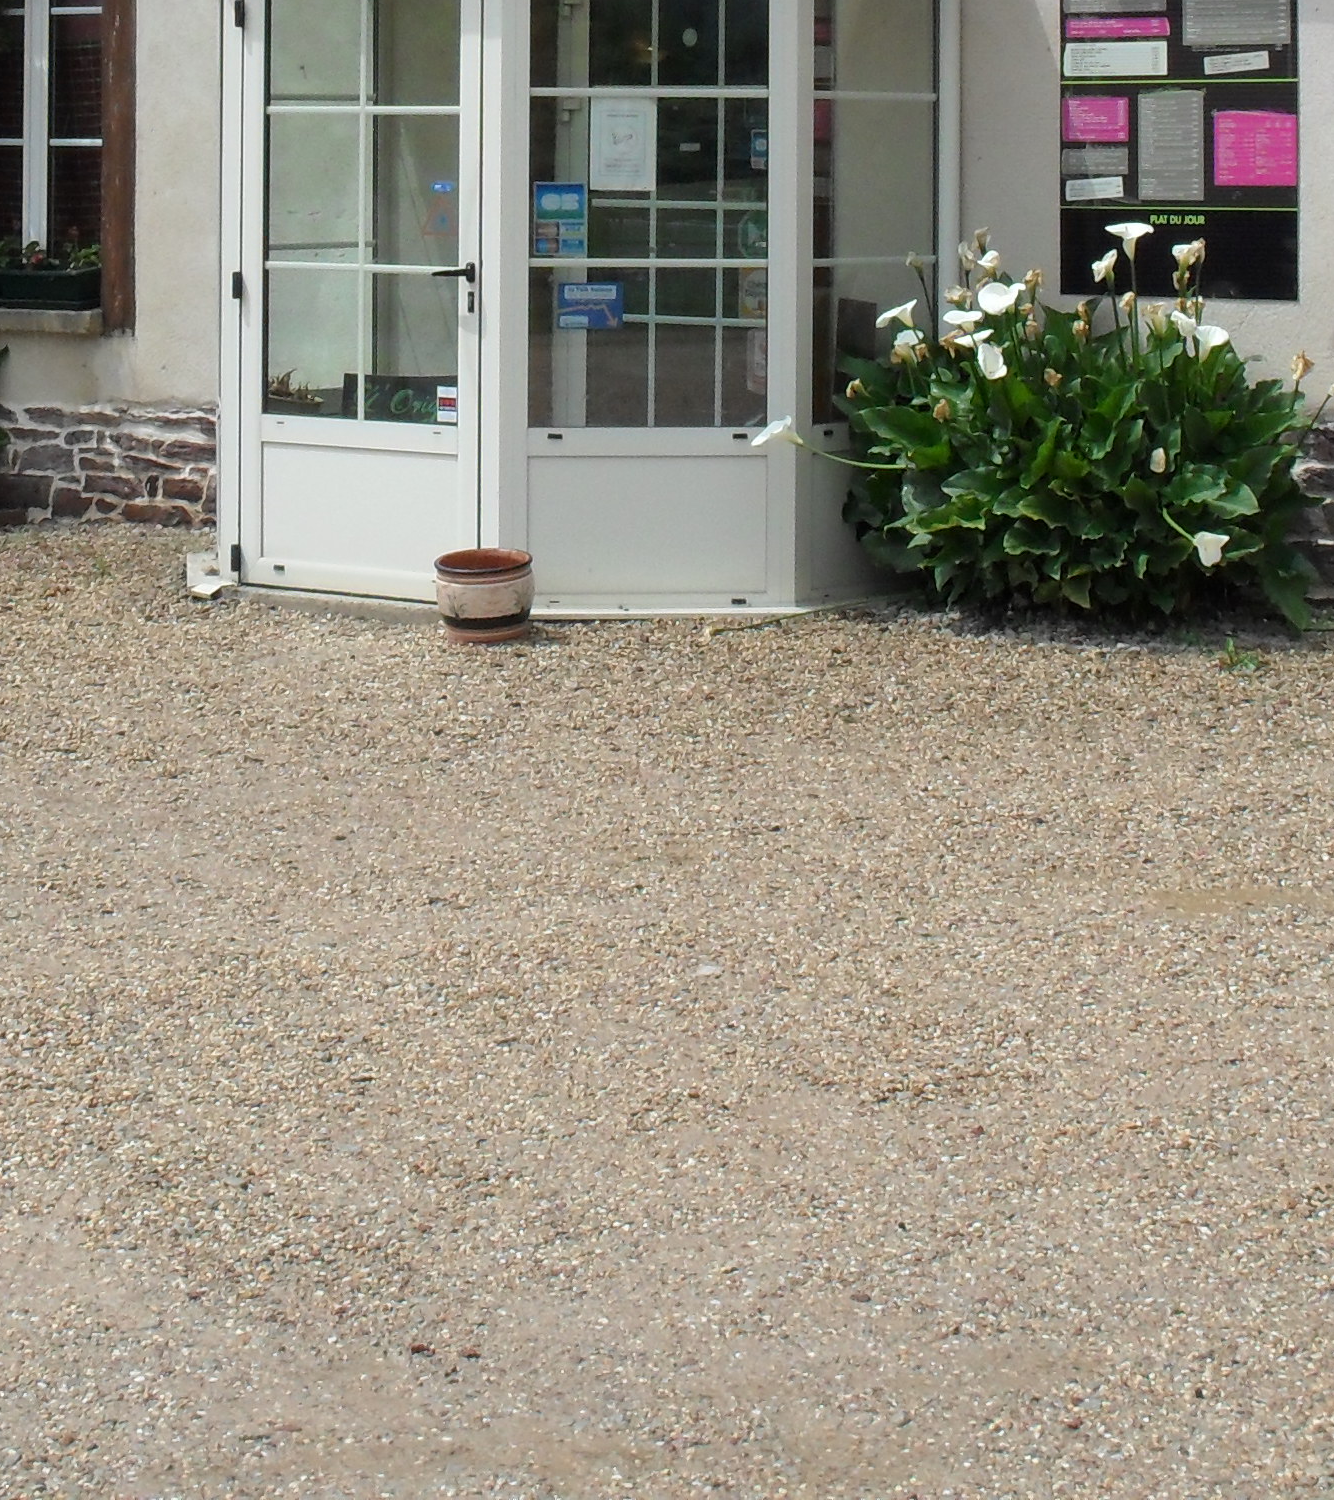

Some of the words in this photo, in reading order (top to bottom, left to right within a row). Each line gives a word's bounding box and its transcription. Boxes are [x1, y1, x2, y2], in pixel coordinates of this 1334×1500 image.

[1150, 214, 1167, 225] PLAT
[1169, 214, 1182, 225] DU
[1183, 214, 1206, 225] JOUR
